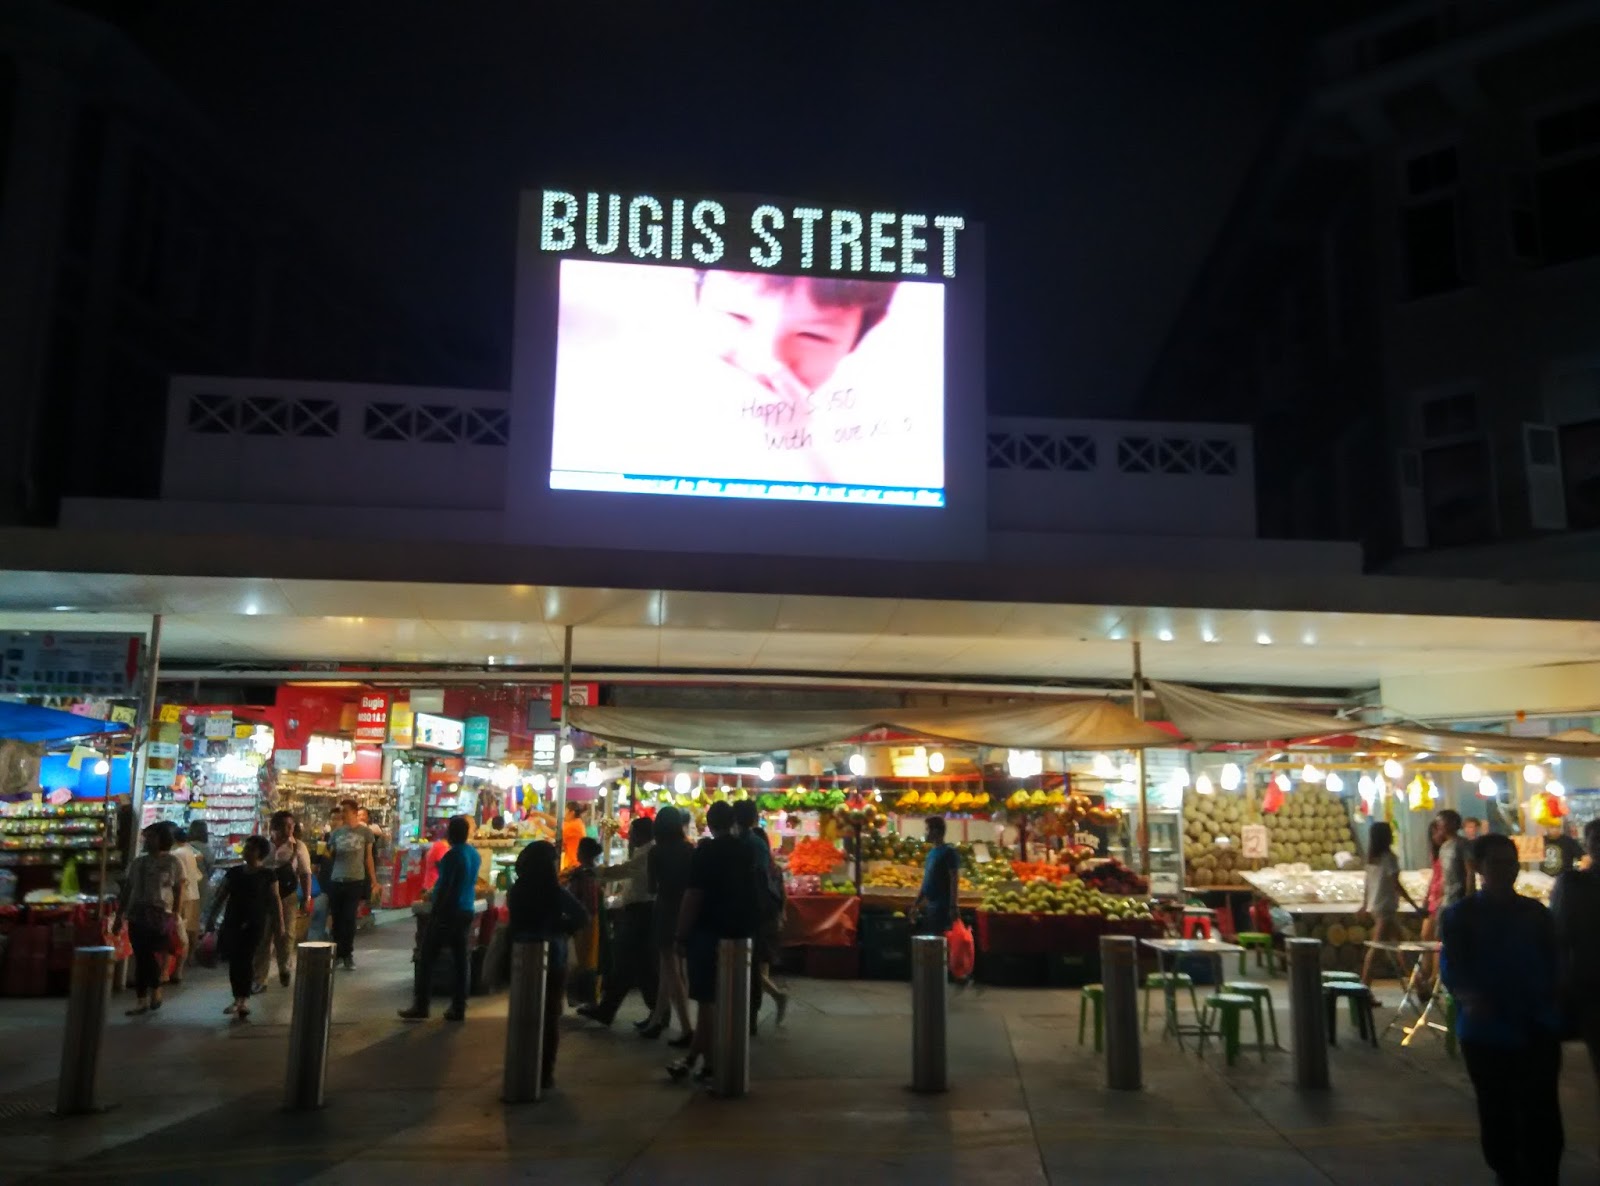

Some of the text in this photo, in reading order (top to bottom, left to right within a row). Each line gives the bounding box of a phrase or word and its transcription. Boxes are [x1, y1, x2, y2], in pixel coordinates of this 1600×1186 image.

[540, 190, 965, 277] BUGIS STREET
[741, 398, 797, 427] Happy
[362, 696, 385, 710] Bugis
